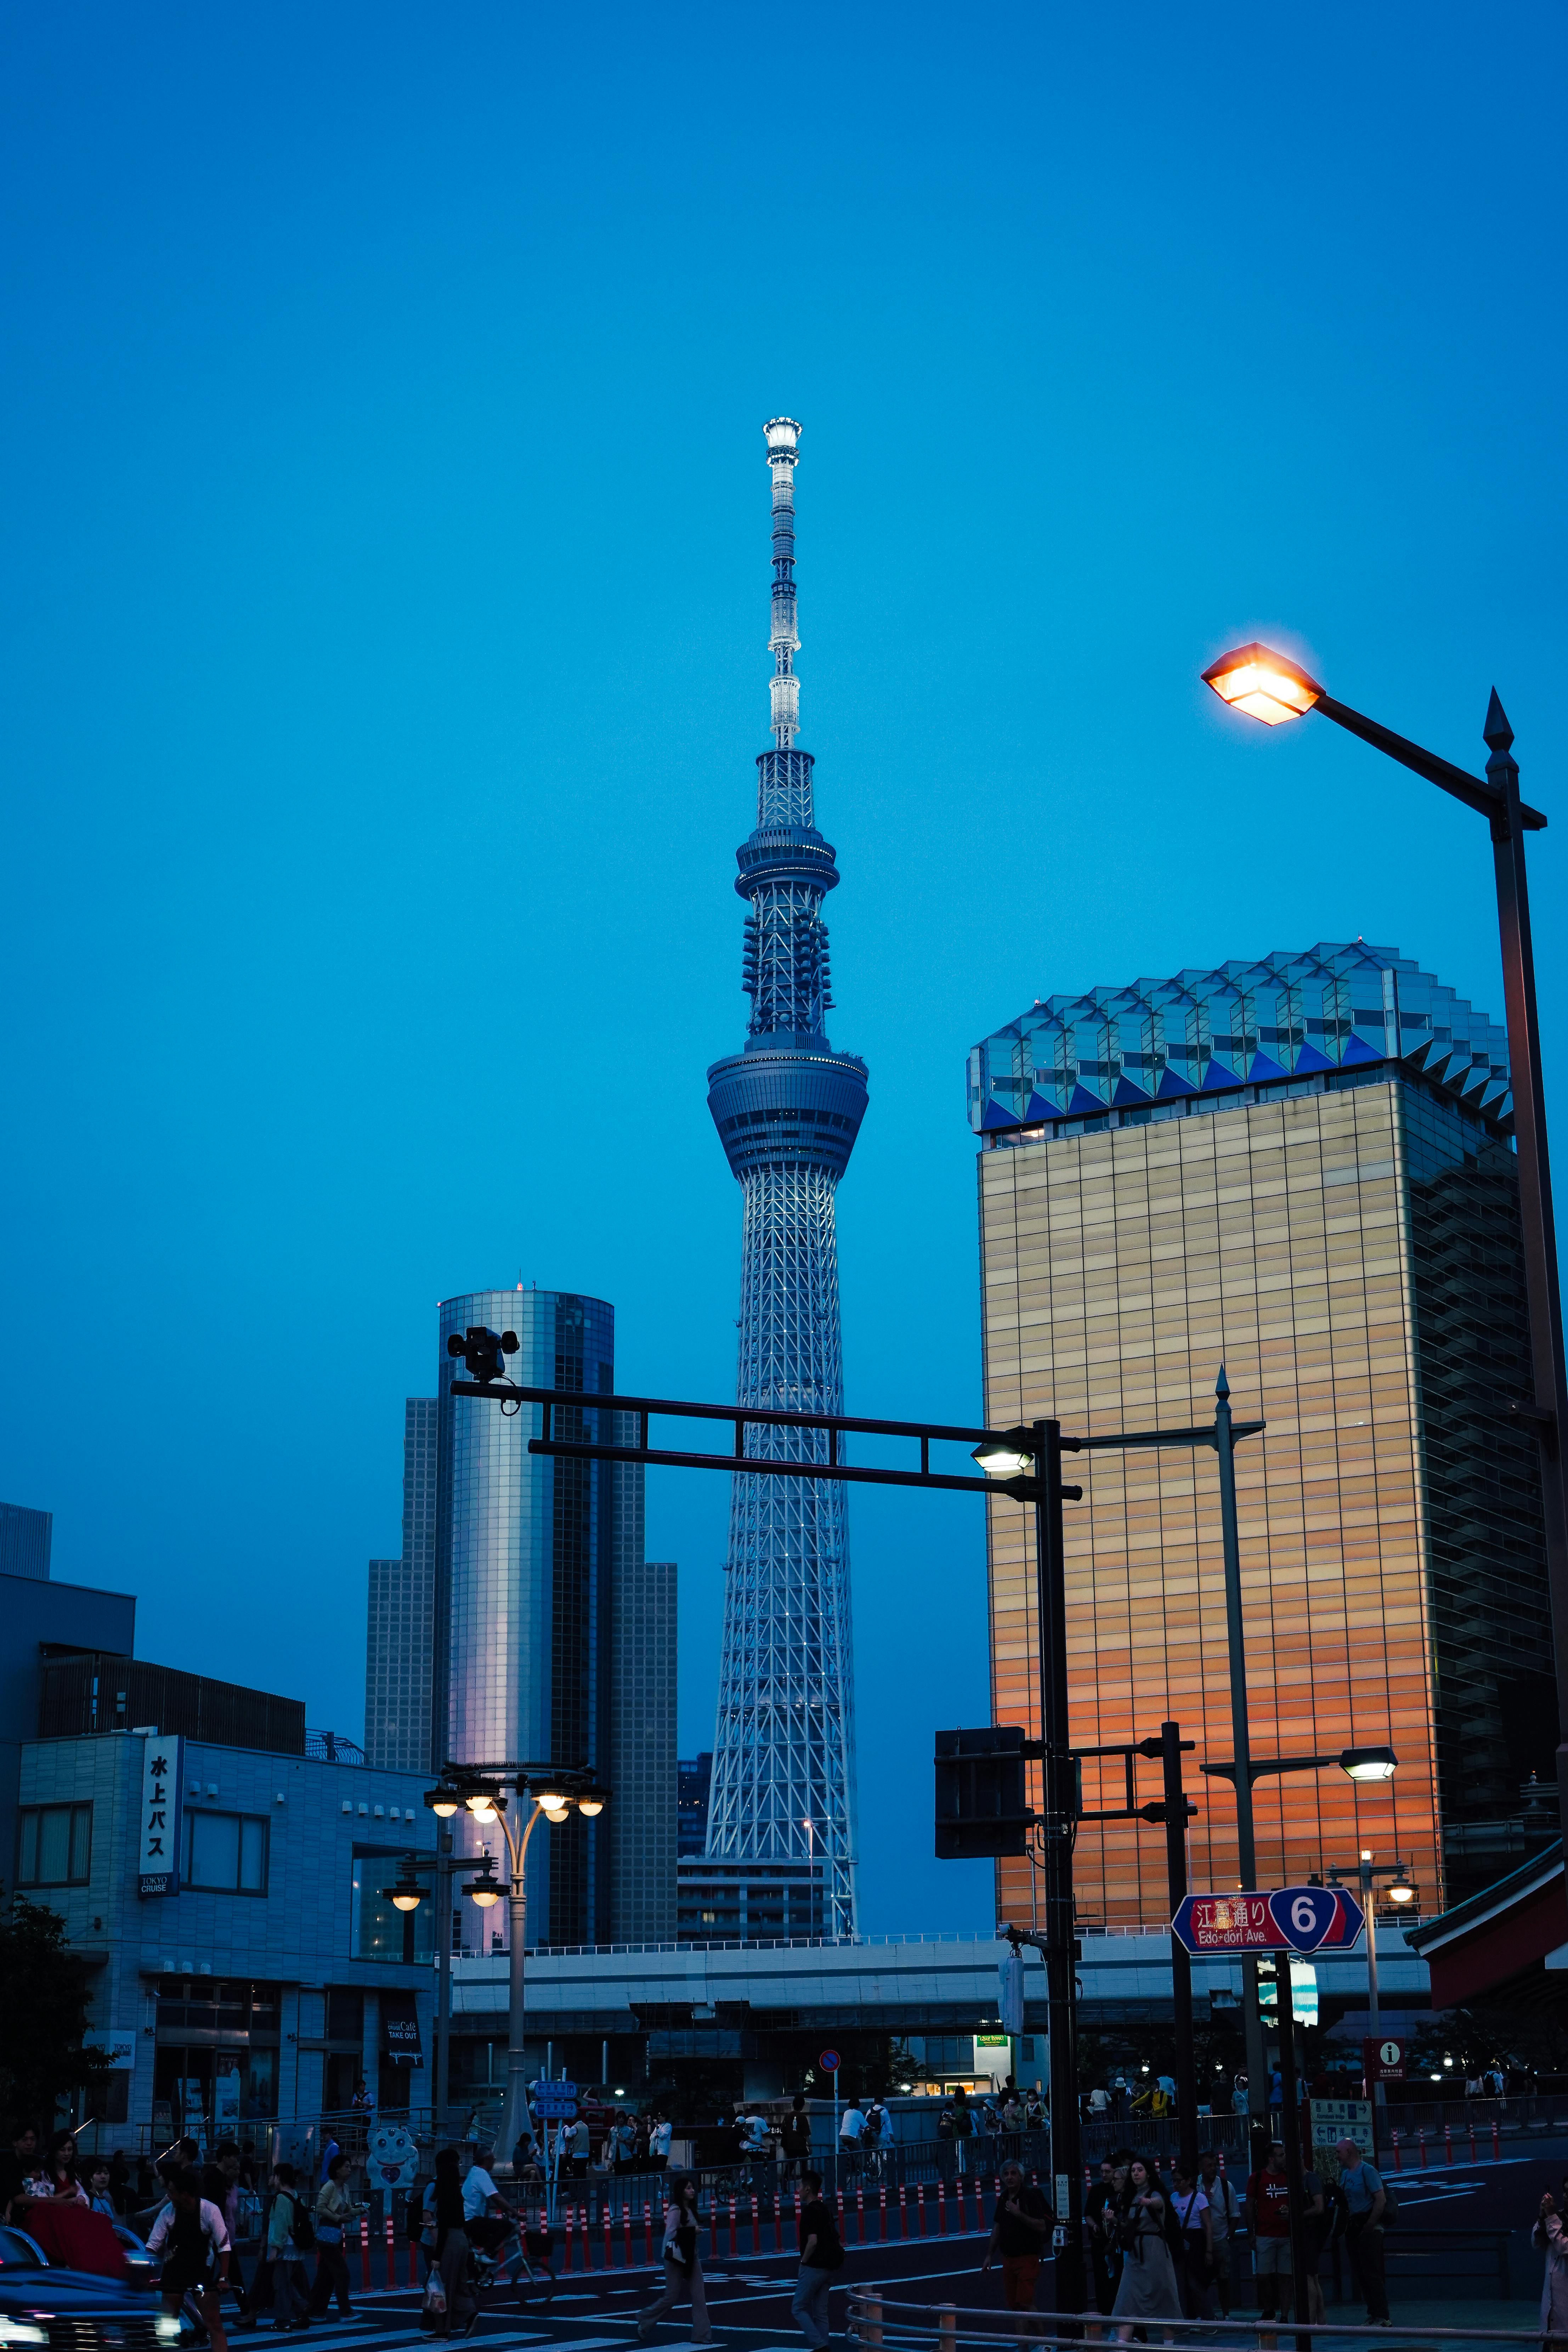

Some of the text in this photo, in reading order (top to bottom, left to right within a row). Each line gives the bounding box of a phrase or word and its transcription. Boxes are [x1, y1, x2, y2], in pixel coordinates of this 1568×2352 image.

[147, 1756, 167, 1856] 水上バス
[142, 1877, 167, 1885] TOKYO
[141, 1884, 166, 1893] CRUISE
[1197, 1902, 1265, 1929] 江戸通り
[1291, 1896, 1316, 1933] 6
[1199, 1929, 1266, 1944] Edo-dori Ave.
[401, 2021, 416, 2031] Café
[1339, 2127, 1369, 2137] 浅草寺
